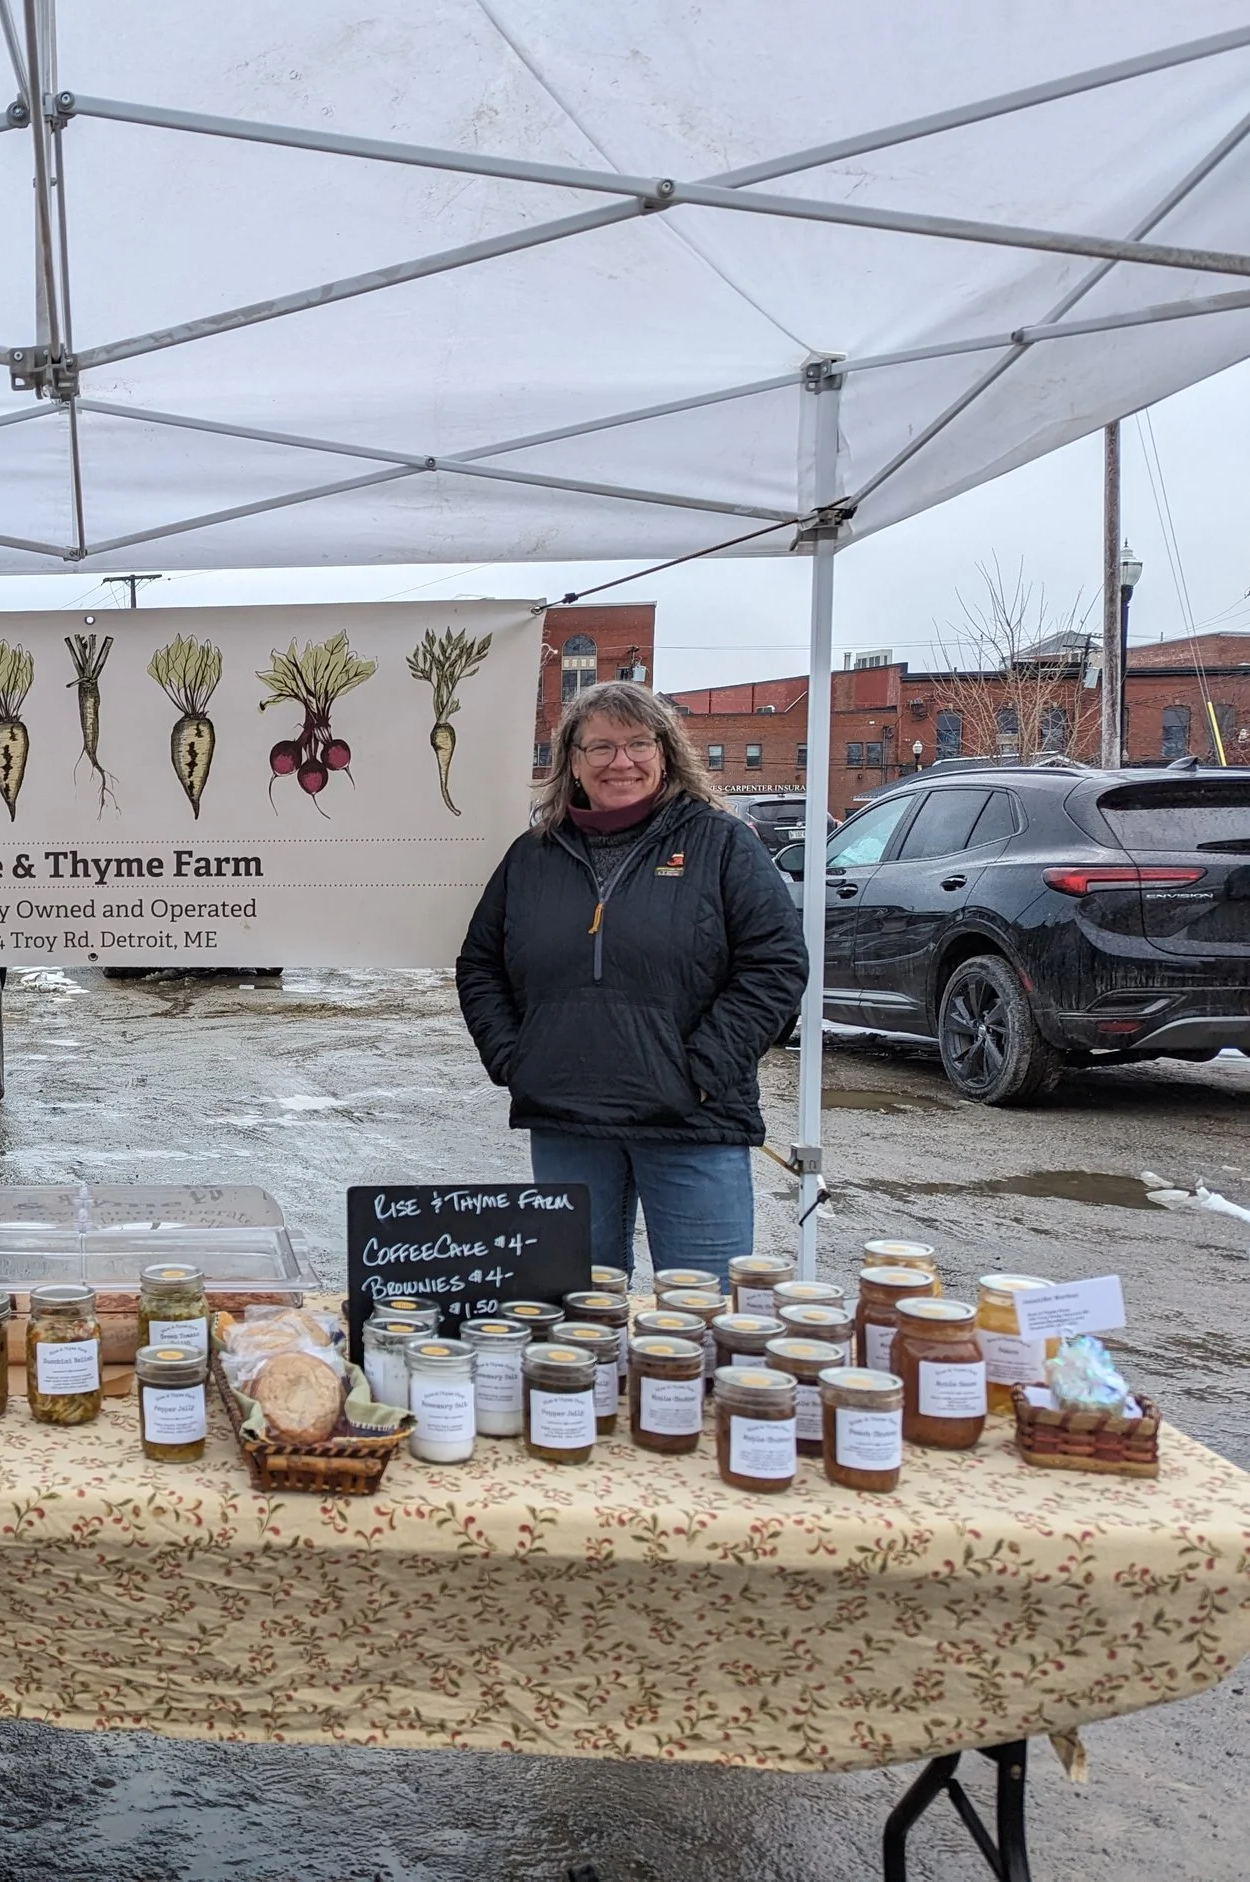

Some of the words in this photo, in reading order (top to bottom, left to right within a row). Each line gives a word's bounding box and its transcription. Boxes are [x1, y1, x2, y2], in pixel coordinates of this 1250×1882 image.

[11, 853, 37, 879] &
[45, 850, 165, 886] Thyme
[173, 849, 265, 879] Farm
[16, 899, 96, 919] Owned
[102, 899, 144, 919] and
[151, 898, 258, 923] Operated
[10, 931, 58, 953] Troy
[63, 930, 95, 949] Rd.
[100, 930, 178, 951] Detroit,
[184, 930, 218, 949] ME
